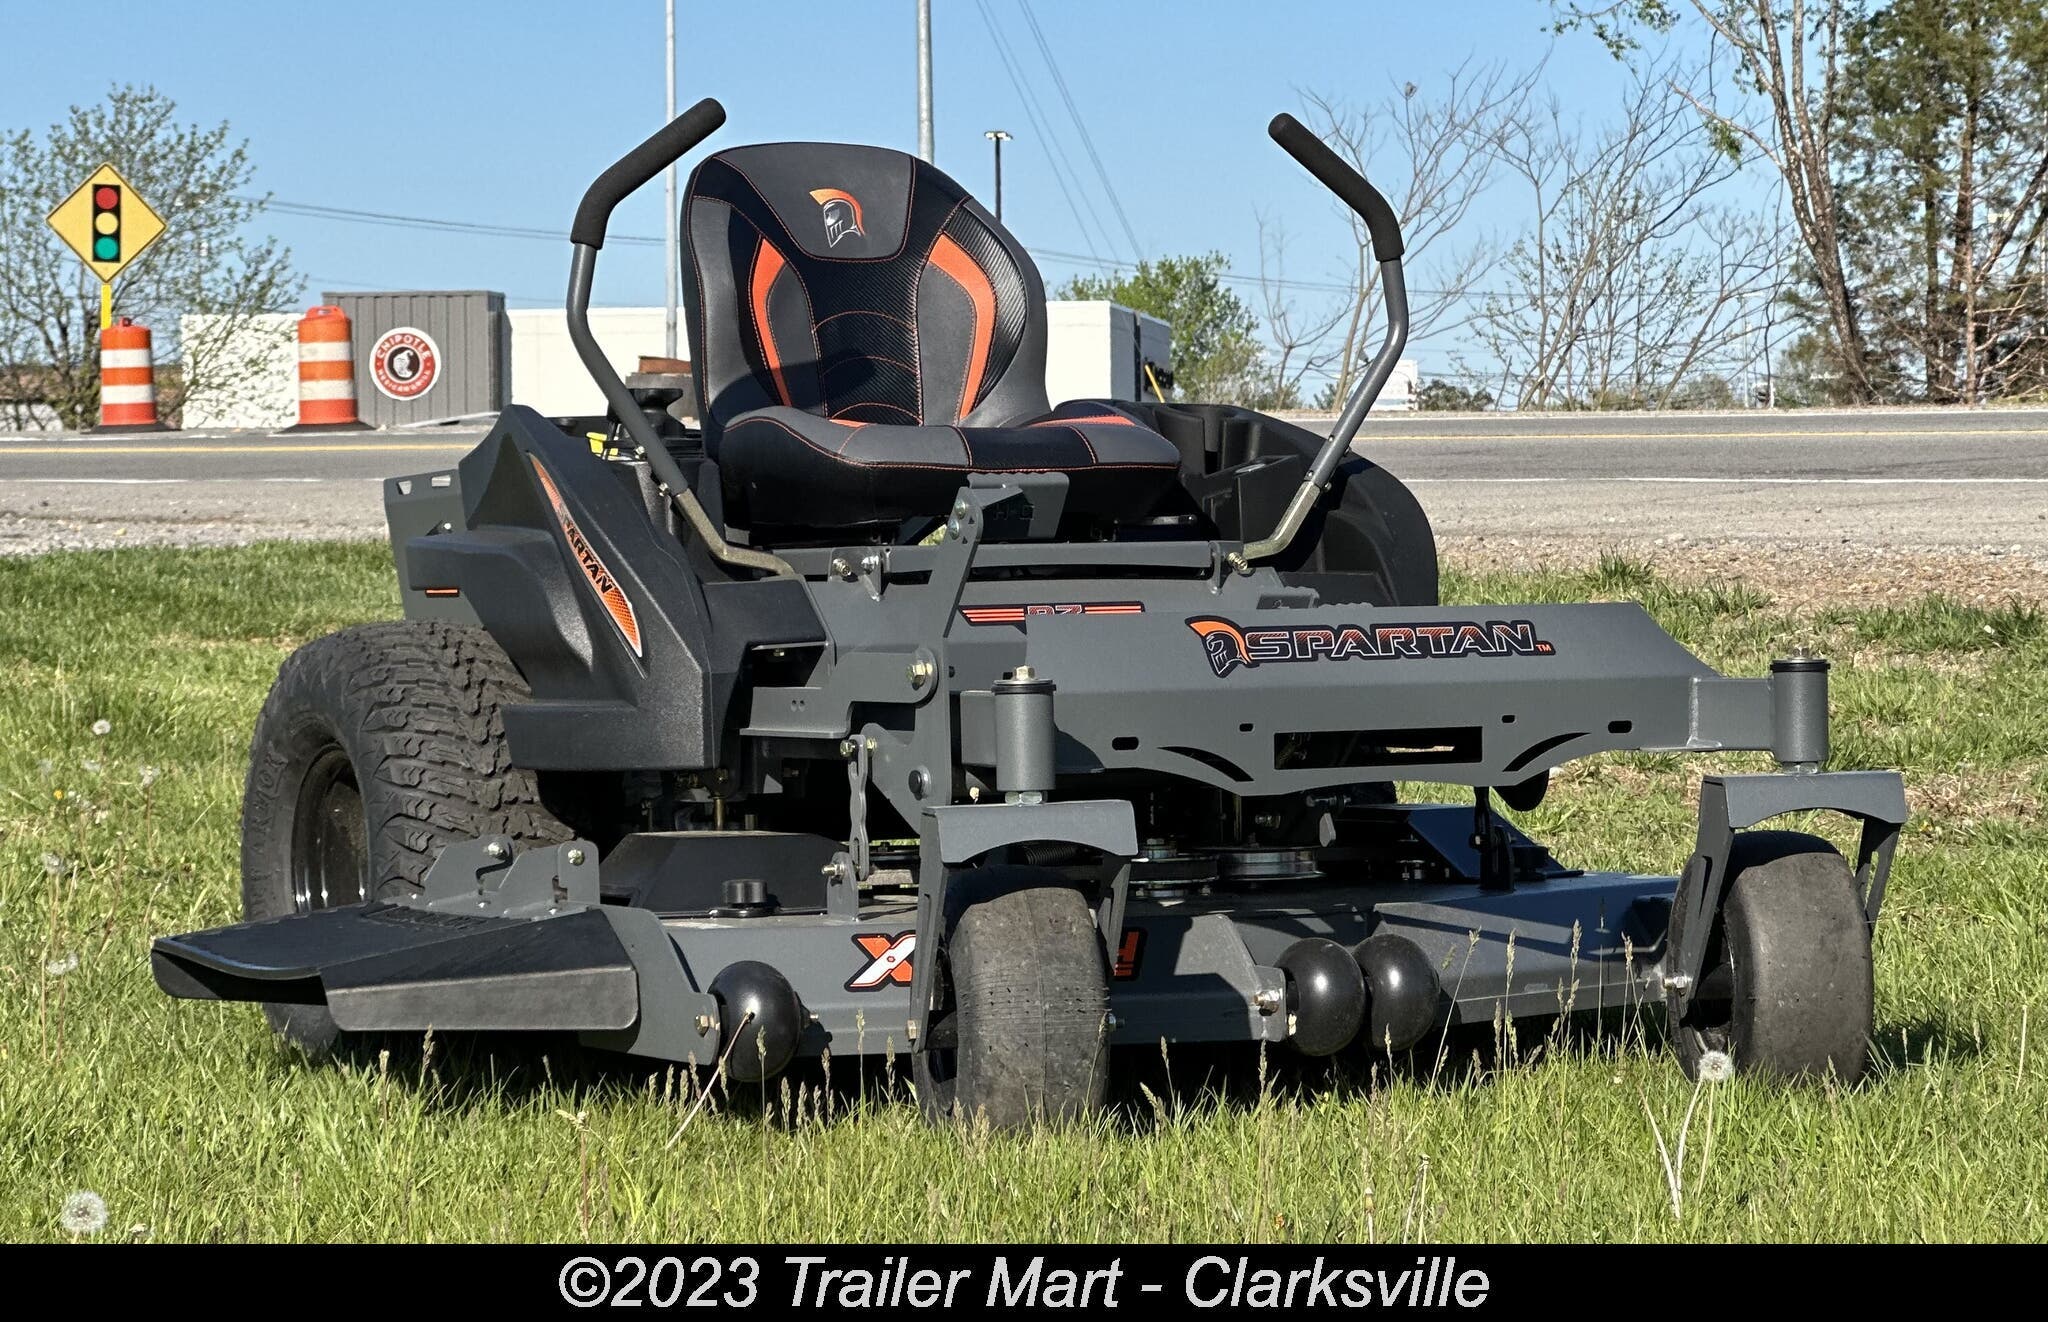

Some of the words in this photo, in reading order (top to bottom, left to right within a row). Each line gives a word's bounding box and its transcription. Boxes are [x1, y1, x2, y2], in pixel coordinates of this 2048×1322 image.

[376, 334, 432, 360] CHIPOTLE
[557, 502, 614, 594] ARTAN
[1245, 623, 1535, 661] SPARTAN
